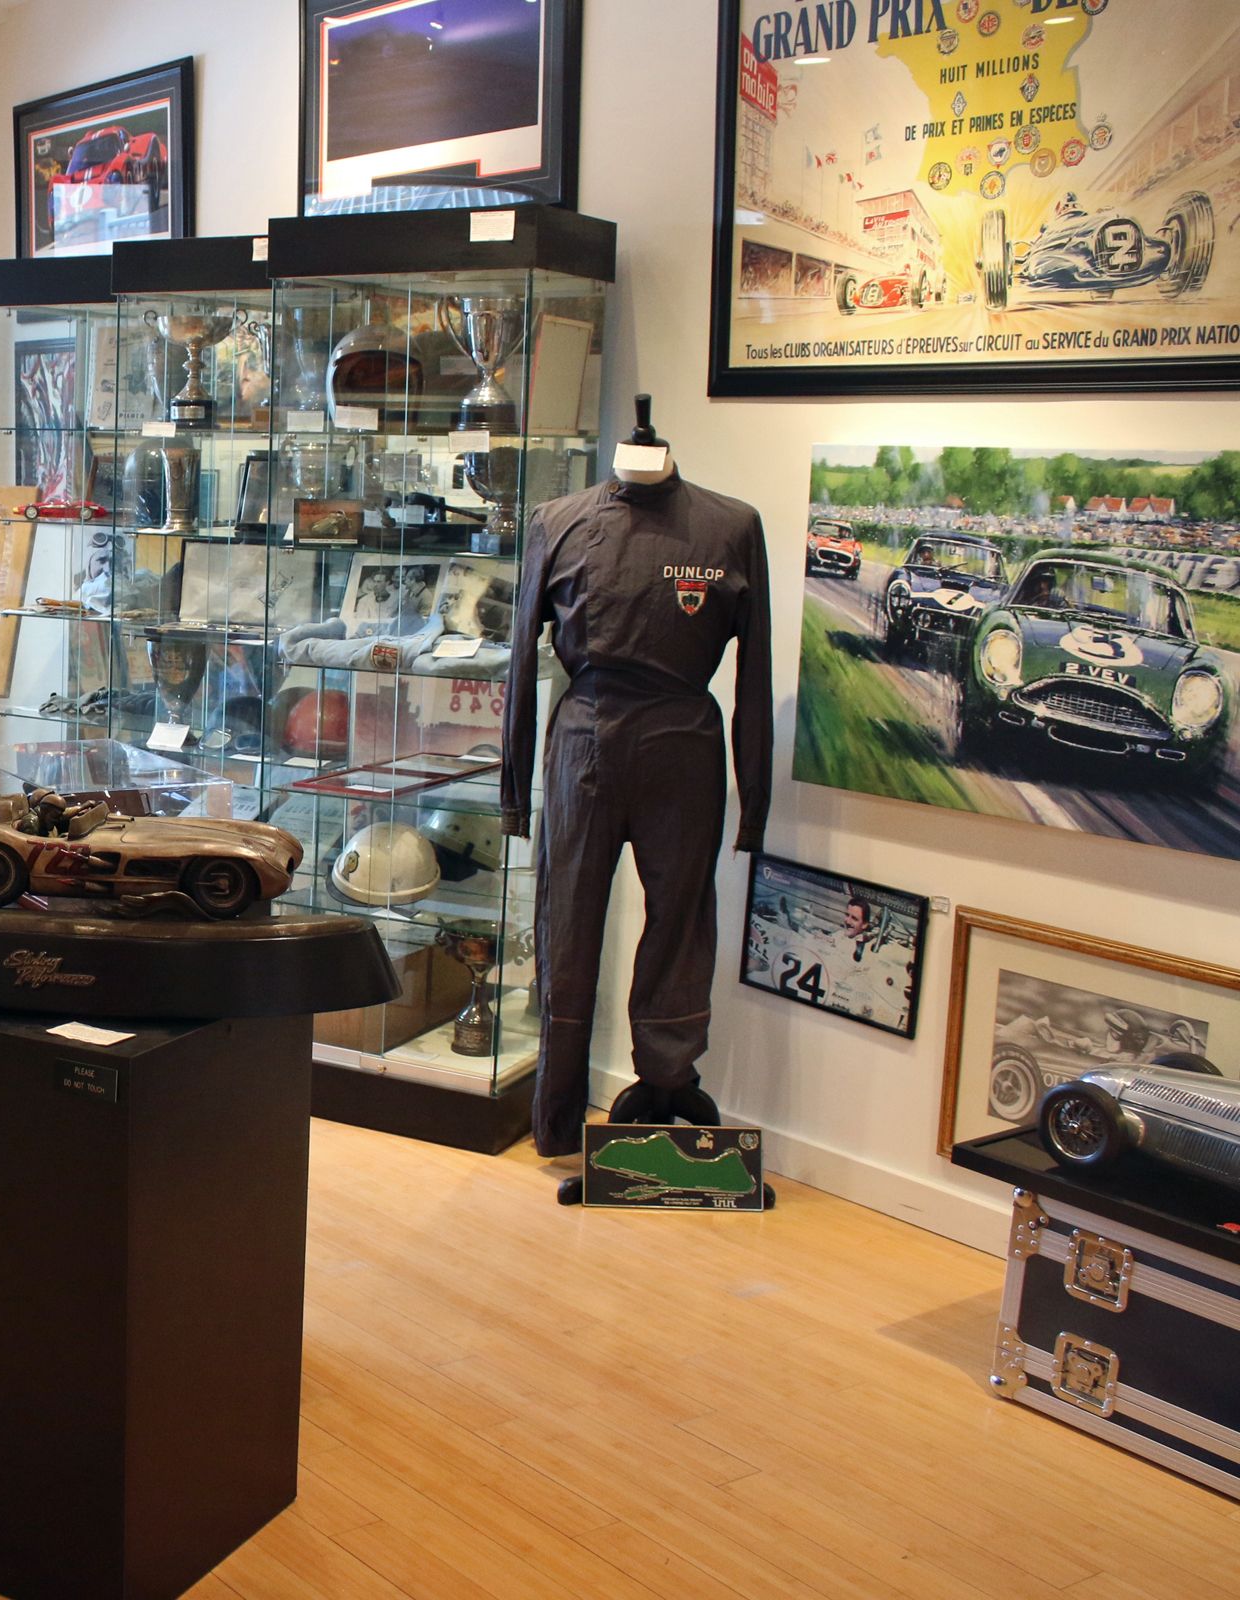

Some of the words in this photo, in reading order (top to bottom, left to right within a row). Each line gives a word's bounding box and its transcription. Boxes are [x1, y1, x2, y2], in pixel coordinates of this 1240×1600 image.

[752, 0, 857, 64] GRAND
[940, 65, 968, 84] HUIT
[975, 53, 1040, 78] MILLIONS
[904, 125, 916, 141] DE
[922, 120, 946, 138] PRIX
[951, 119, 964, 135] ET
[969, 112, 1004, 133] PRIMES
[1010, 110, 1023, 127] EN
[745, 344, 768, 360] Tous
[769, 344, 783, 359] les
[783, 342, 811, 359] CLUBS
[812, 339, 894, 357] ORGANISATEURS
[958, 340, 974, 352] sur
[975, 333, 1022, 352] CIRCUIT
[1025, 340, 1039, 351] au
[1041, 330, 1092, 350] SERVICE
[1093, 330, 1109, 348] du
[1112, 328, 1158, 348] GRAND
[1160, 326, 1192, 346] PRIX
[663, 565, 724, 581] DUNLOP
[1084, 625, 1126, 658] 3
[1065, 662, 1079, 674] 2
[1089, 665, 1129, 685] VEV
[780, 951, 826, 1004] 24
[64, 1078, 72, 1087] DO
[73, 1080, 85, 1089] NOT
[87, 1083, 105, 1095] TOUCH
[74, 1066, 96, 1079] PLEASE
